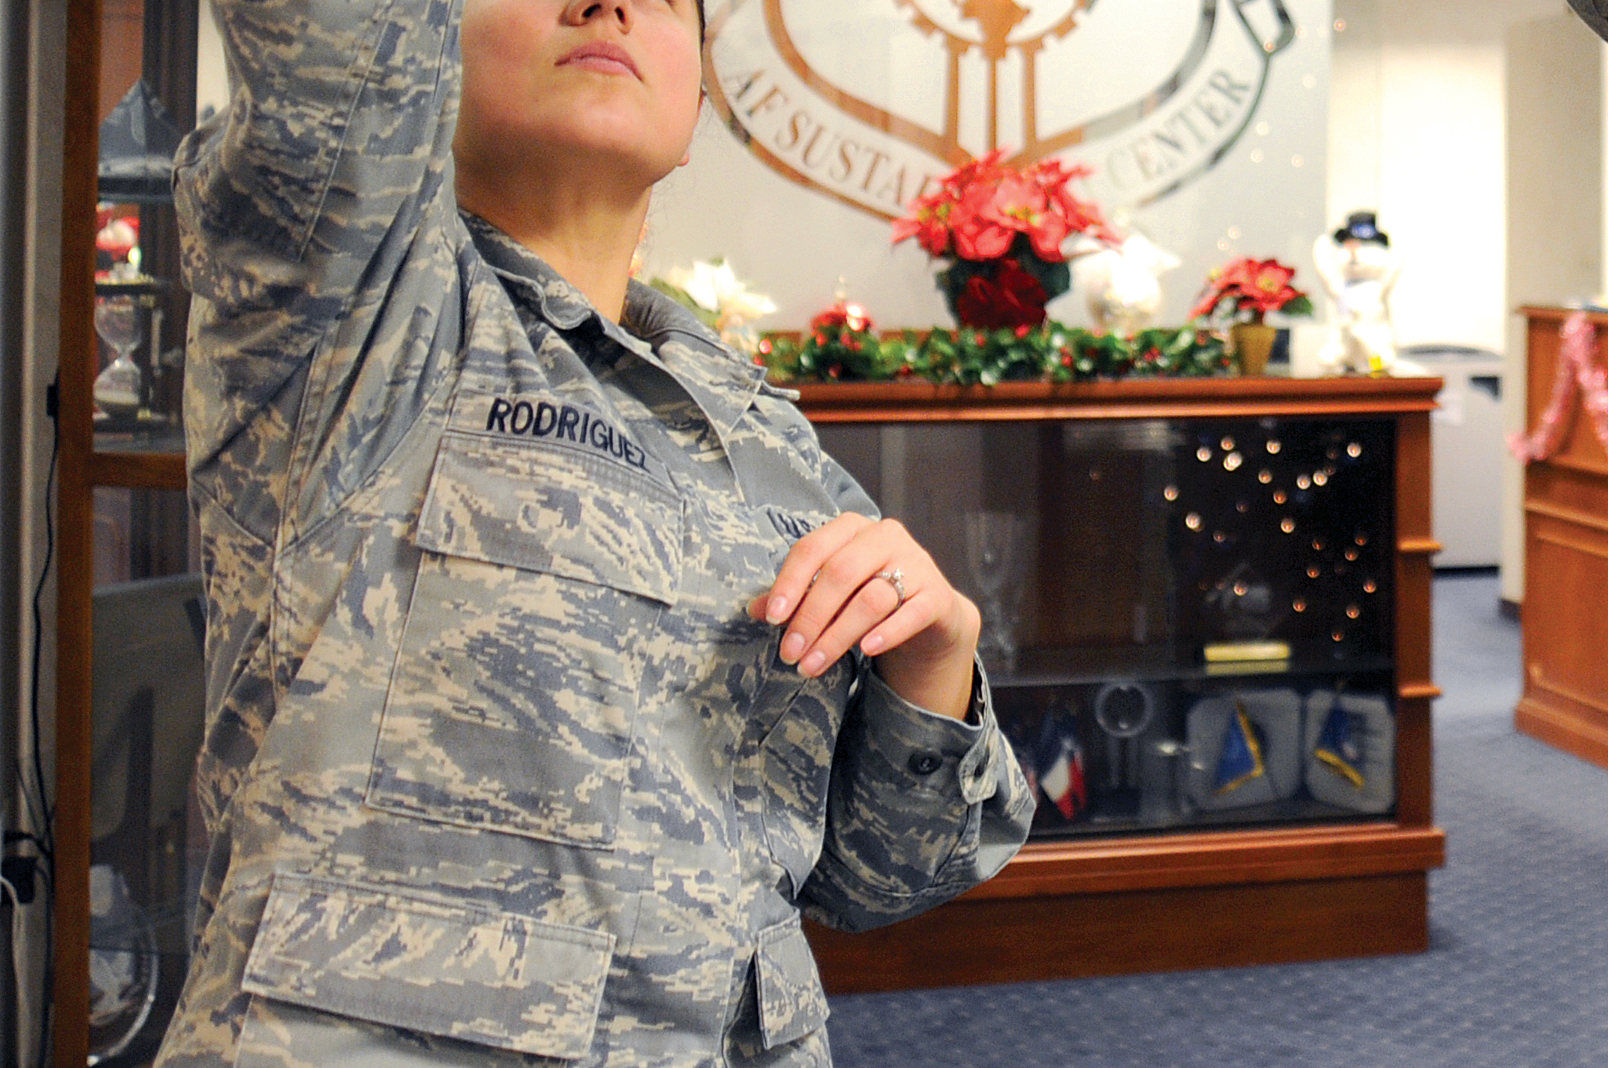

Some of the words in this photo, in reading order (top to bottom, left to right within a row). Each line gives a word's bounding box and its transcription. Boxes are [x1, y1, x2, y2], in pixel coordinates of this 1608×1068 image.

[725, 69, 789, 118] AF
[1105, 68, 1251, 191] CENTER
[486, 397, 651, 473] RODRIGUEZ
